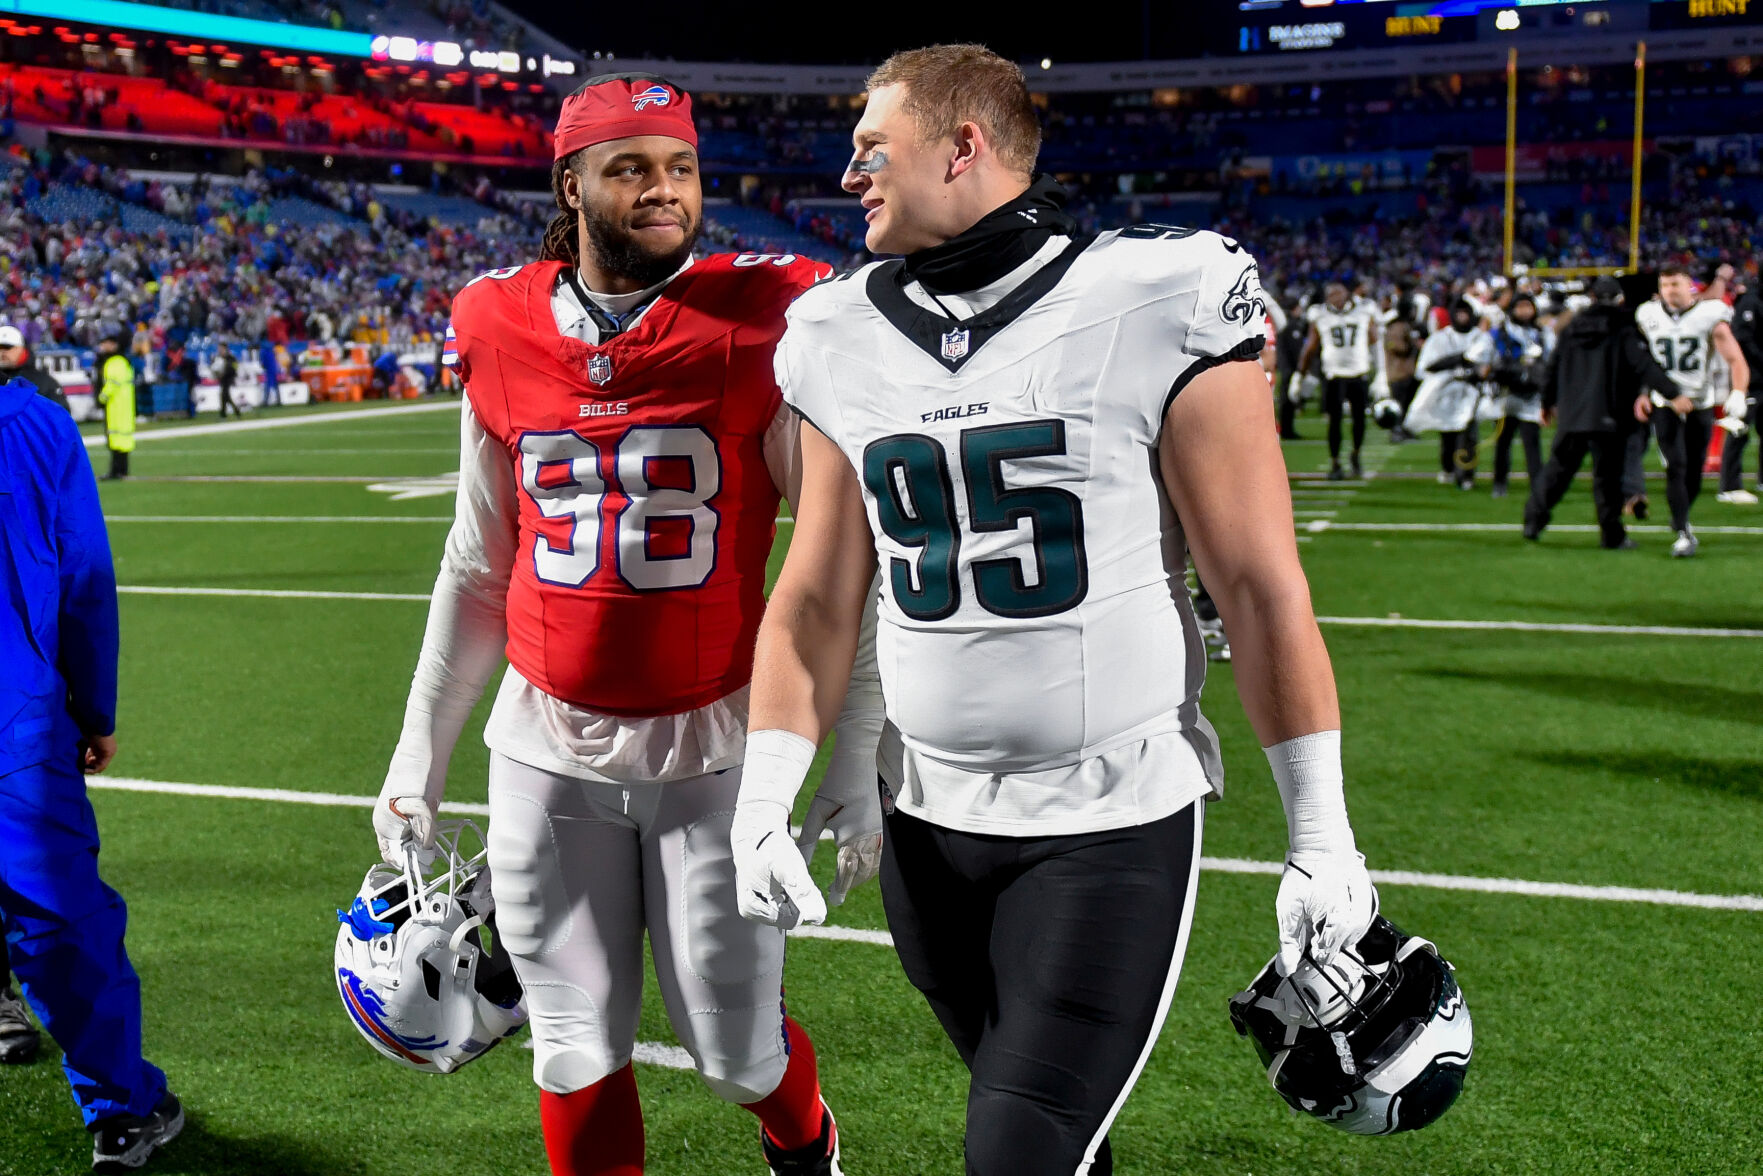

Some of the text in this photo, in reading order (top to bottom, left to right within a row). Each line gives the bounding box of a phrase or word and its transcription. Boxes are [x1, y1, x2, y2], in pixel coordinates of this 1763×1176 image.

[1330, 323, 1358, 348] 97
[946, 343, 964, 356] NFL
[1655, 336, 1701, 372] 32
[578, 402, 629, 417] BILLS
[919, 401, 991, 424] EAGLES
[517, 423, 724, 592] 98
[863, 418, 1089, 622] 95
